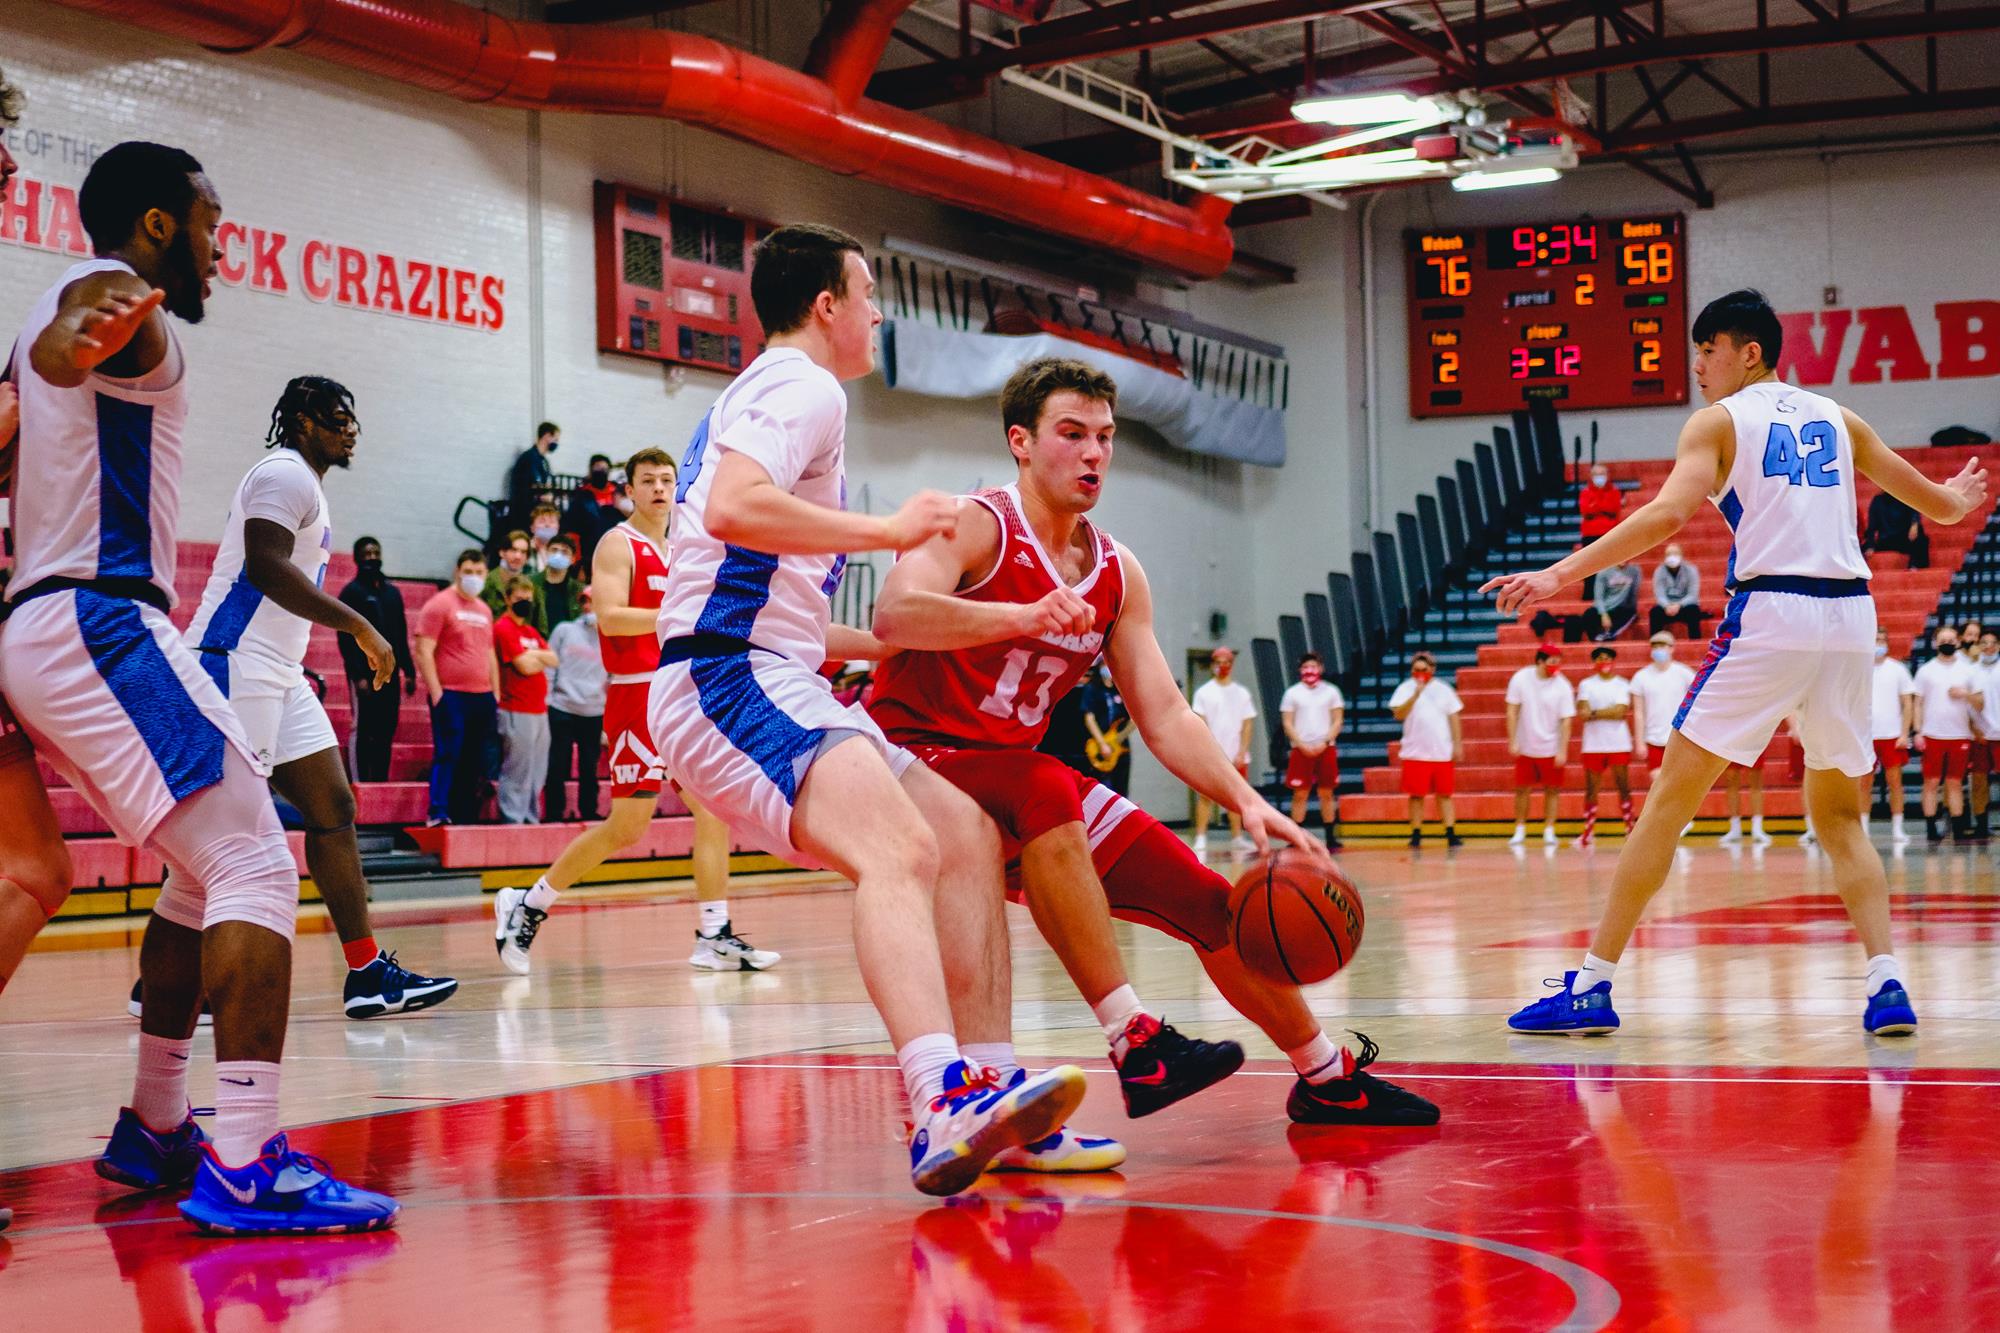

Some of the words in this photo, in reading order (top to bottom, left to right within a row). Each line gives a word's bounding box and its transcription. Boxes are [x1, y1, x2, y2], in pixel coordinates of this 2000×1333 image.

[25, 129, 53, 159] OF
[1512, 225, 1598, 267] 9:34
[1623, 242, 1674, 286] 58
[303, 239, 506, 331] CRAZIES
[1426, 255, 1471, 297] 76
[1575, 273, 1595, 306] 2
[1515, 291, 1550, 307] period
[1439, 351, 1459, 383] 2
[1640, 340, 1661, 372] 2
[1762, 420, 1841, 488] 42
[977, 647, 1069, 727] 13
[613, 764, 641, 784] W
